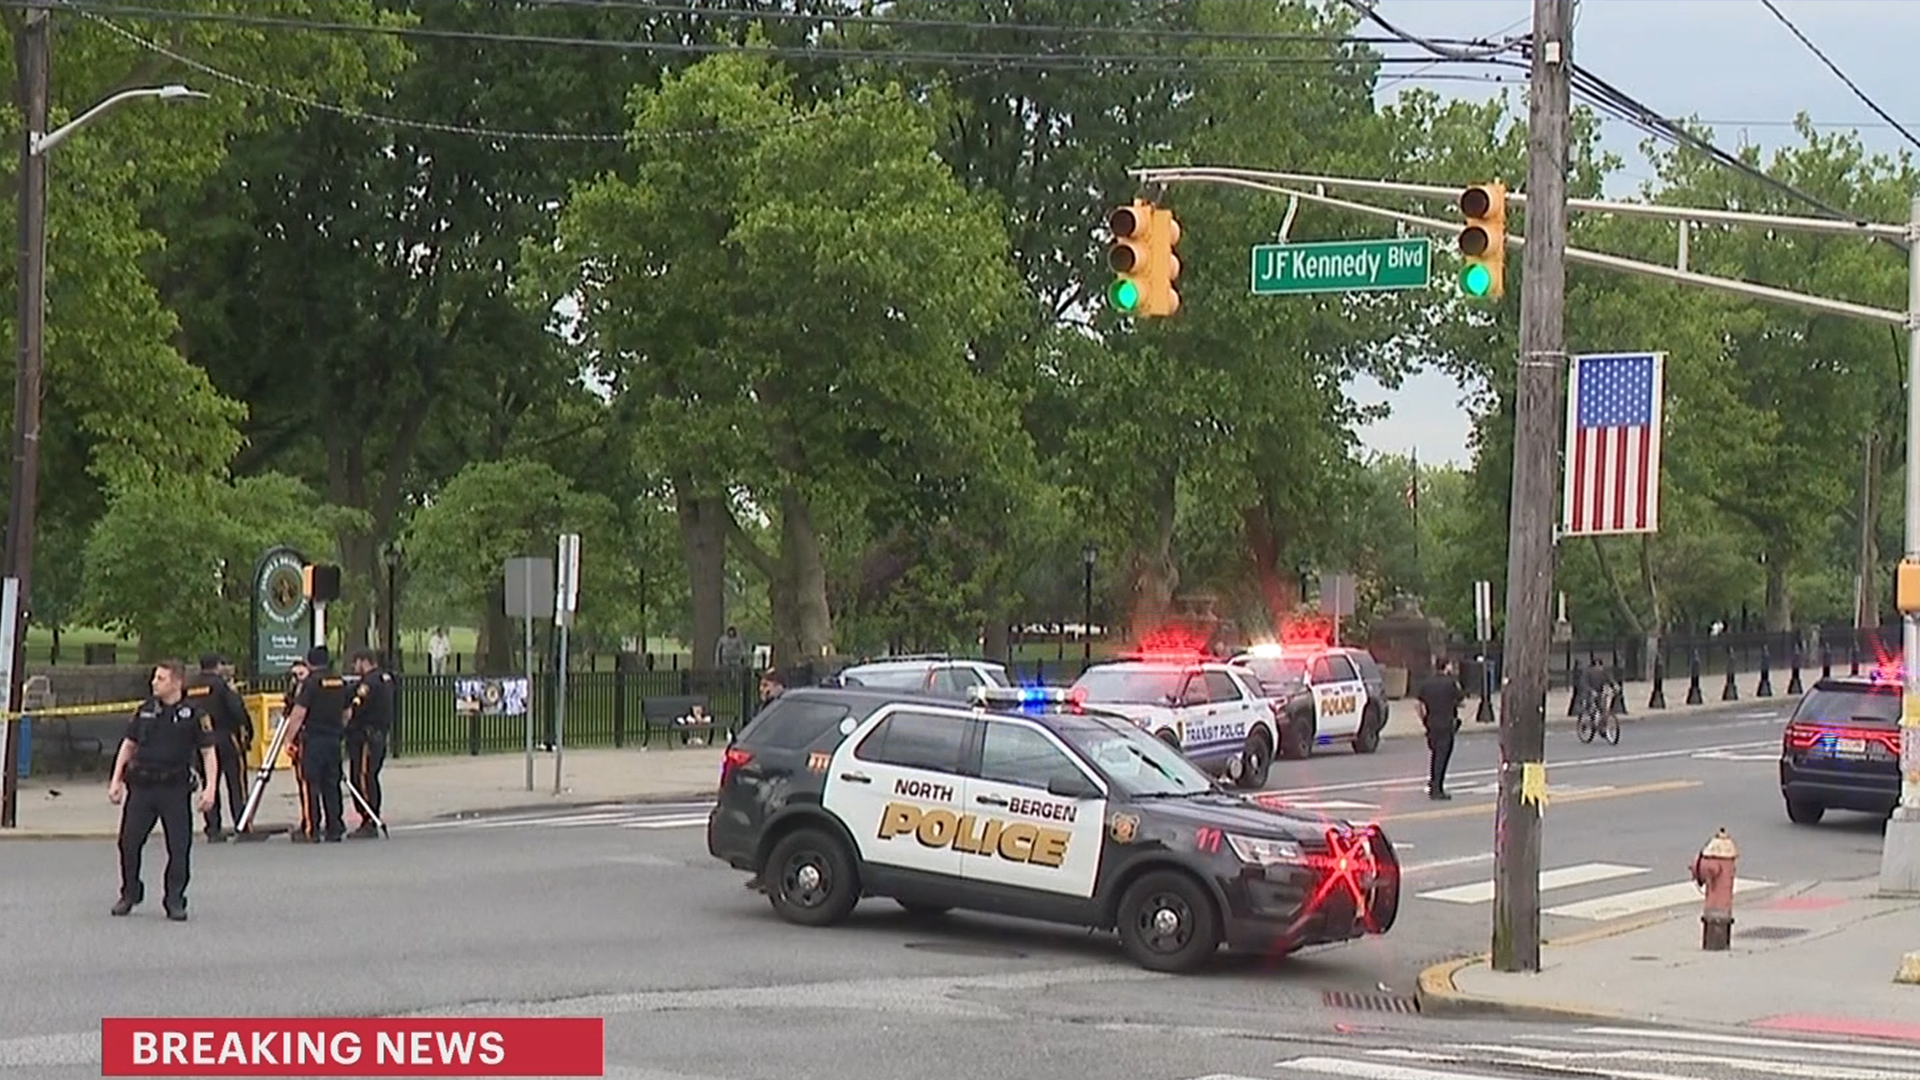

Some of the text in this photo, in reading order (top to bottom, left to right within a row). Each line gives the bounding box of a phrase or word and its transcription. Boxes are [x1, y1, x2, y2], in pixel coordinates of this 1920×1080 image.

[1292, 248, 1381, 284] Kennedy
[1388, 245, 1424, 269] Blvd
[1186, 725, 1219, 741] TRANSIT
[1220, 721, 1246, 738] POLICE
[894, 779, 1077, 823] NORTH BERGEN
[877, 802, 1072, 868] POLICE
[1196, 825, 1222, 853] 11
